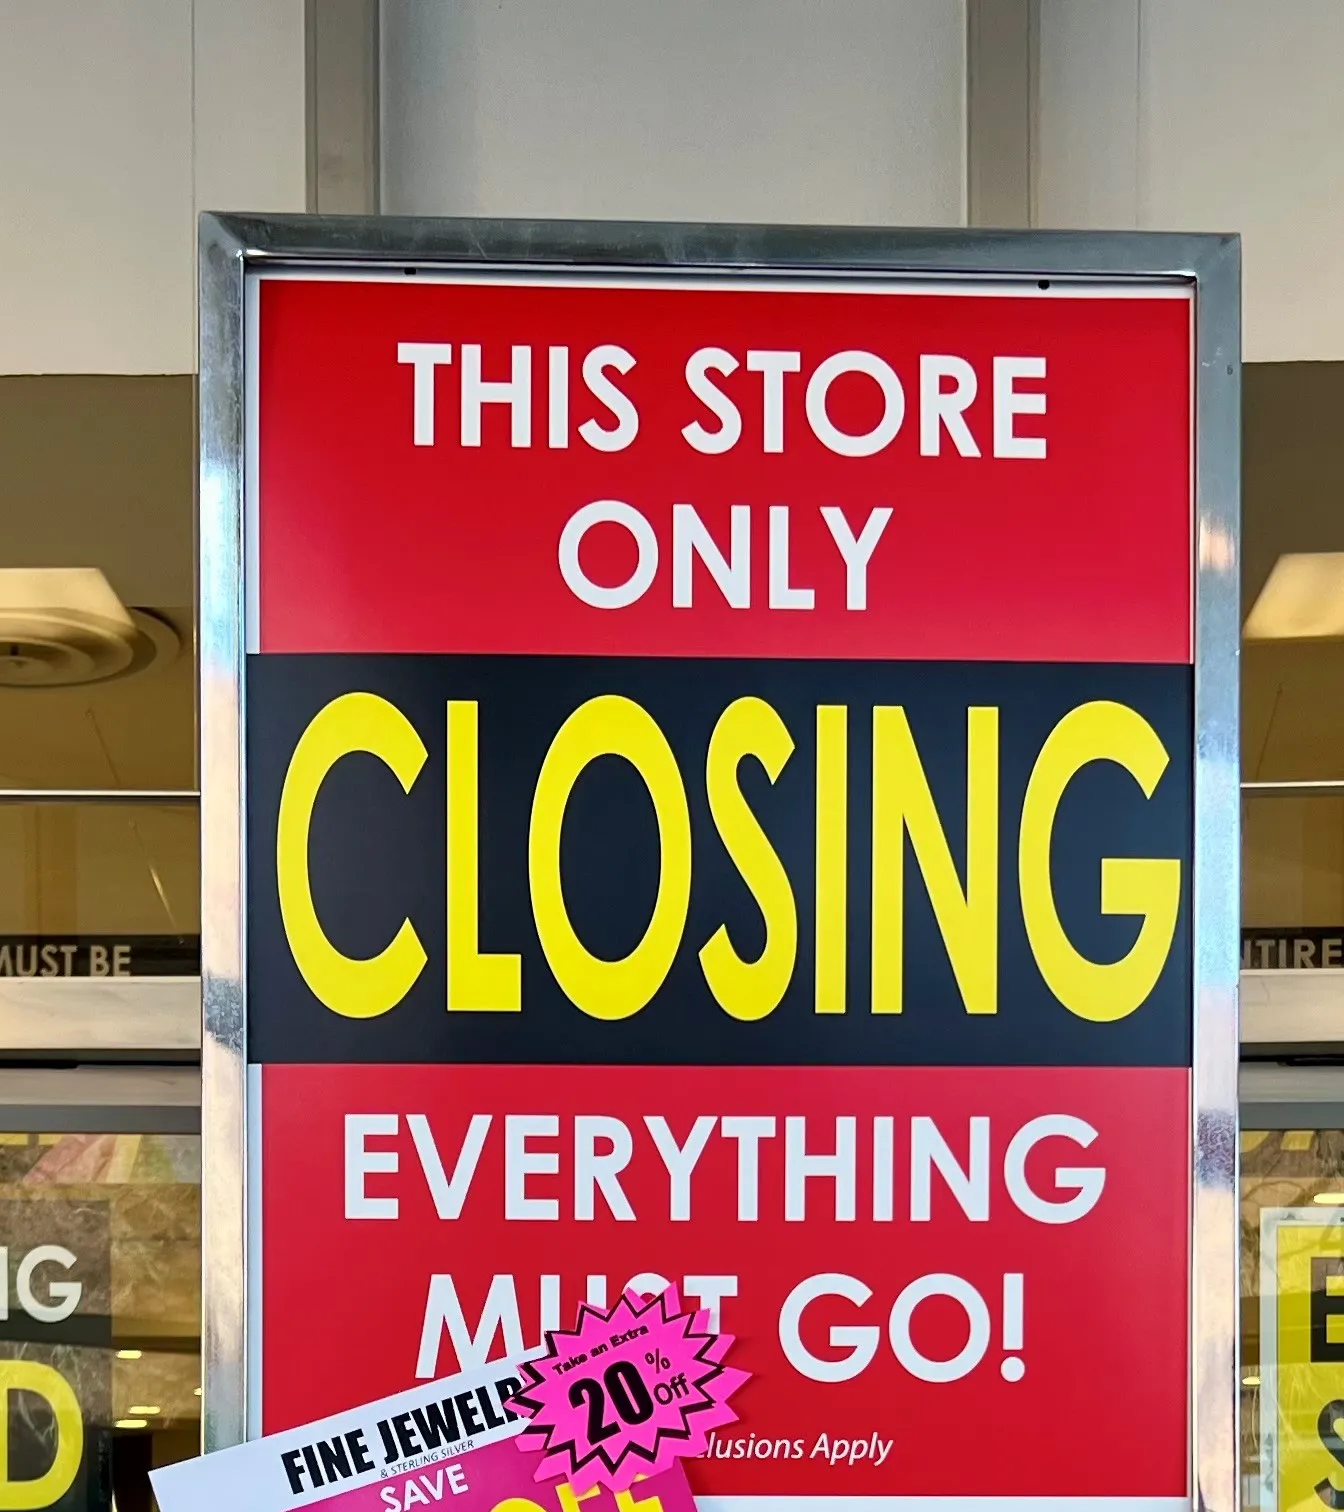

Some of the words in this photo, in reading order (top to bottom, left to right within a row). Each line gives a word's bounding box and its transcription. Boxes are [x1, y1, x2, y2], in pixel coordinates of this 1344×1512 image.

[397, 342, 639, 452] THIS
[683, 349, 1047, 460] STORE
[558, 500, 893, 612] ONLY
[276, 692, 1182, 1022] CLOSING
[90, 945, 131, 977] BE
[1243, 938, 1341, 968] TIRE
[344, 1114, 1106, 1225] EVERYTHING
[415, 1272, 737, 1379] MT
[778, 1272, 1024, 1385] GO!
[552, 1353, 588, 1376] Take
[590, 1342, 608, 1358] an
[610, 1324, 649, 1348] Extra
[281, 1428, 376, 1495] FINE
[377, 1376, 524, 1464] JEWELR
[569, 1361, 654, 1446] 20
[653, 1372, 690, 1405] Off
[697, 1431, 803, 1460] lusions
[810, 1432, 892, 1468] Apply
[391, 1453, 439, 1475] STERLING
[441, 1440, 474, 1460] SILVER
